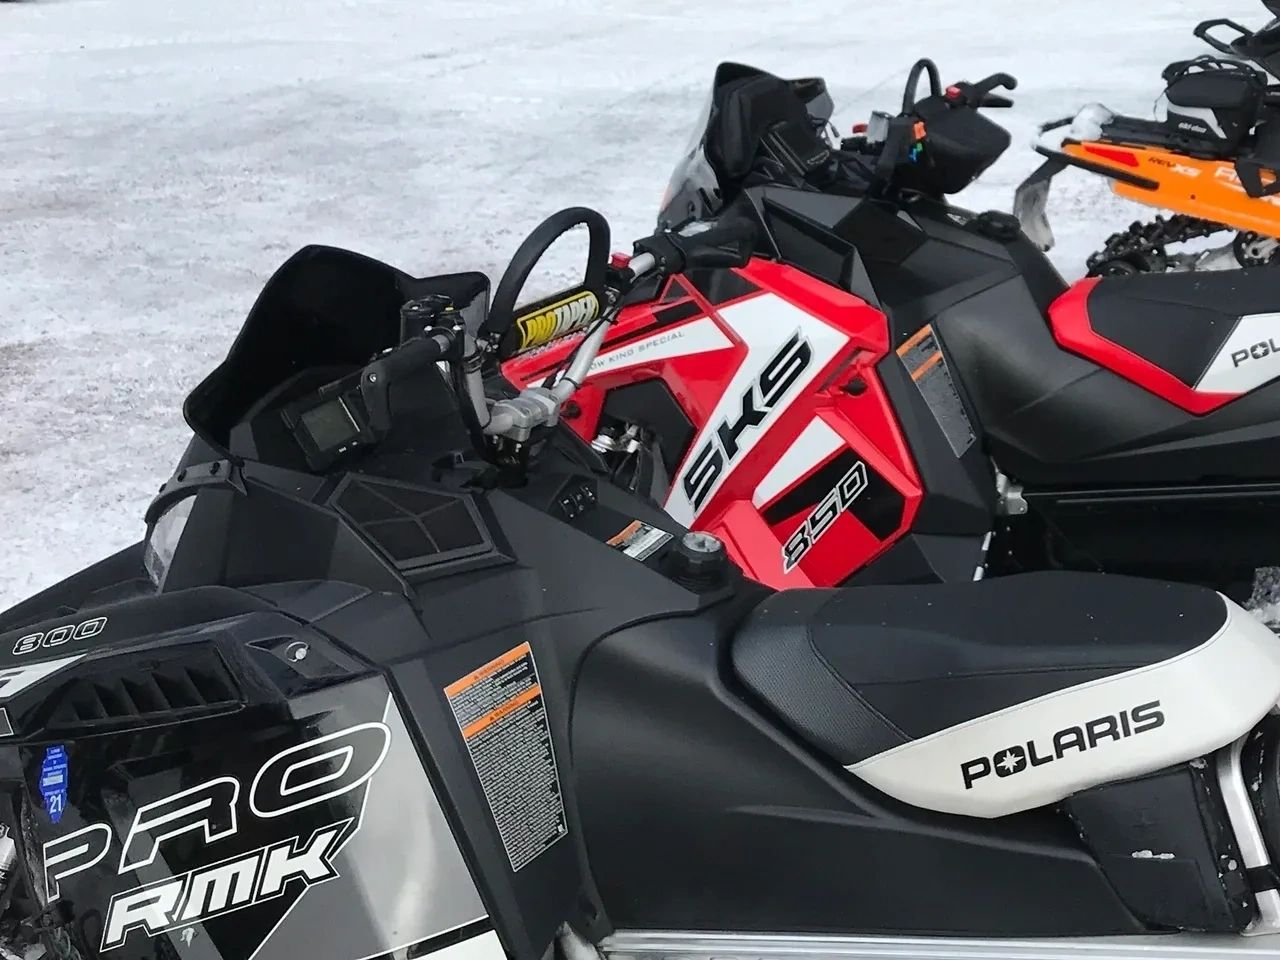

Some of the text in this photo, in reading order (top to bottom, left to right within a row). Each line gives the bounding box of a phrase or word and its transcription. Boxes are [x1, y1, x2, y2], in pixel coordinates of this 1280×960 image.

[608, 349, 635, 363] KING
[638, 331, 685, 352] SPECIAL
[683, 327, 814, 516] SKS
[782, 460, 869, 574] 850
[12, 617, 107, 655] 800
[960, 699, 1165, 790] POLARIS
[43, 722, 392, 903] PRO
[49, 794, 62, 814] 21
[100, 817, 355, 952] RMK
